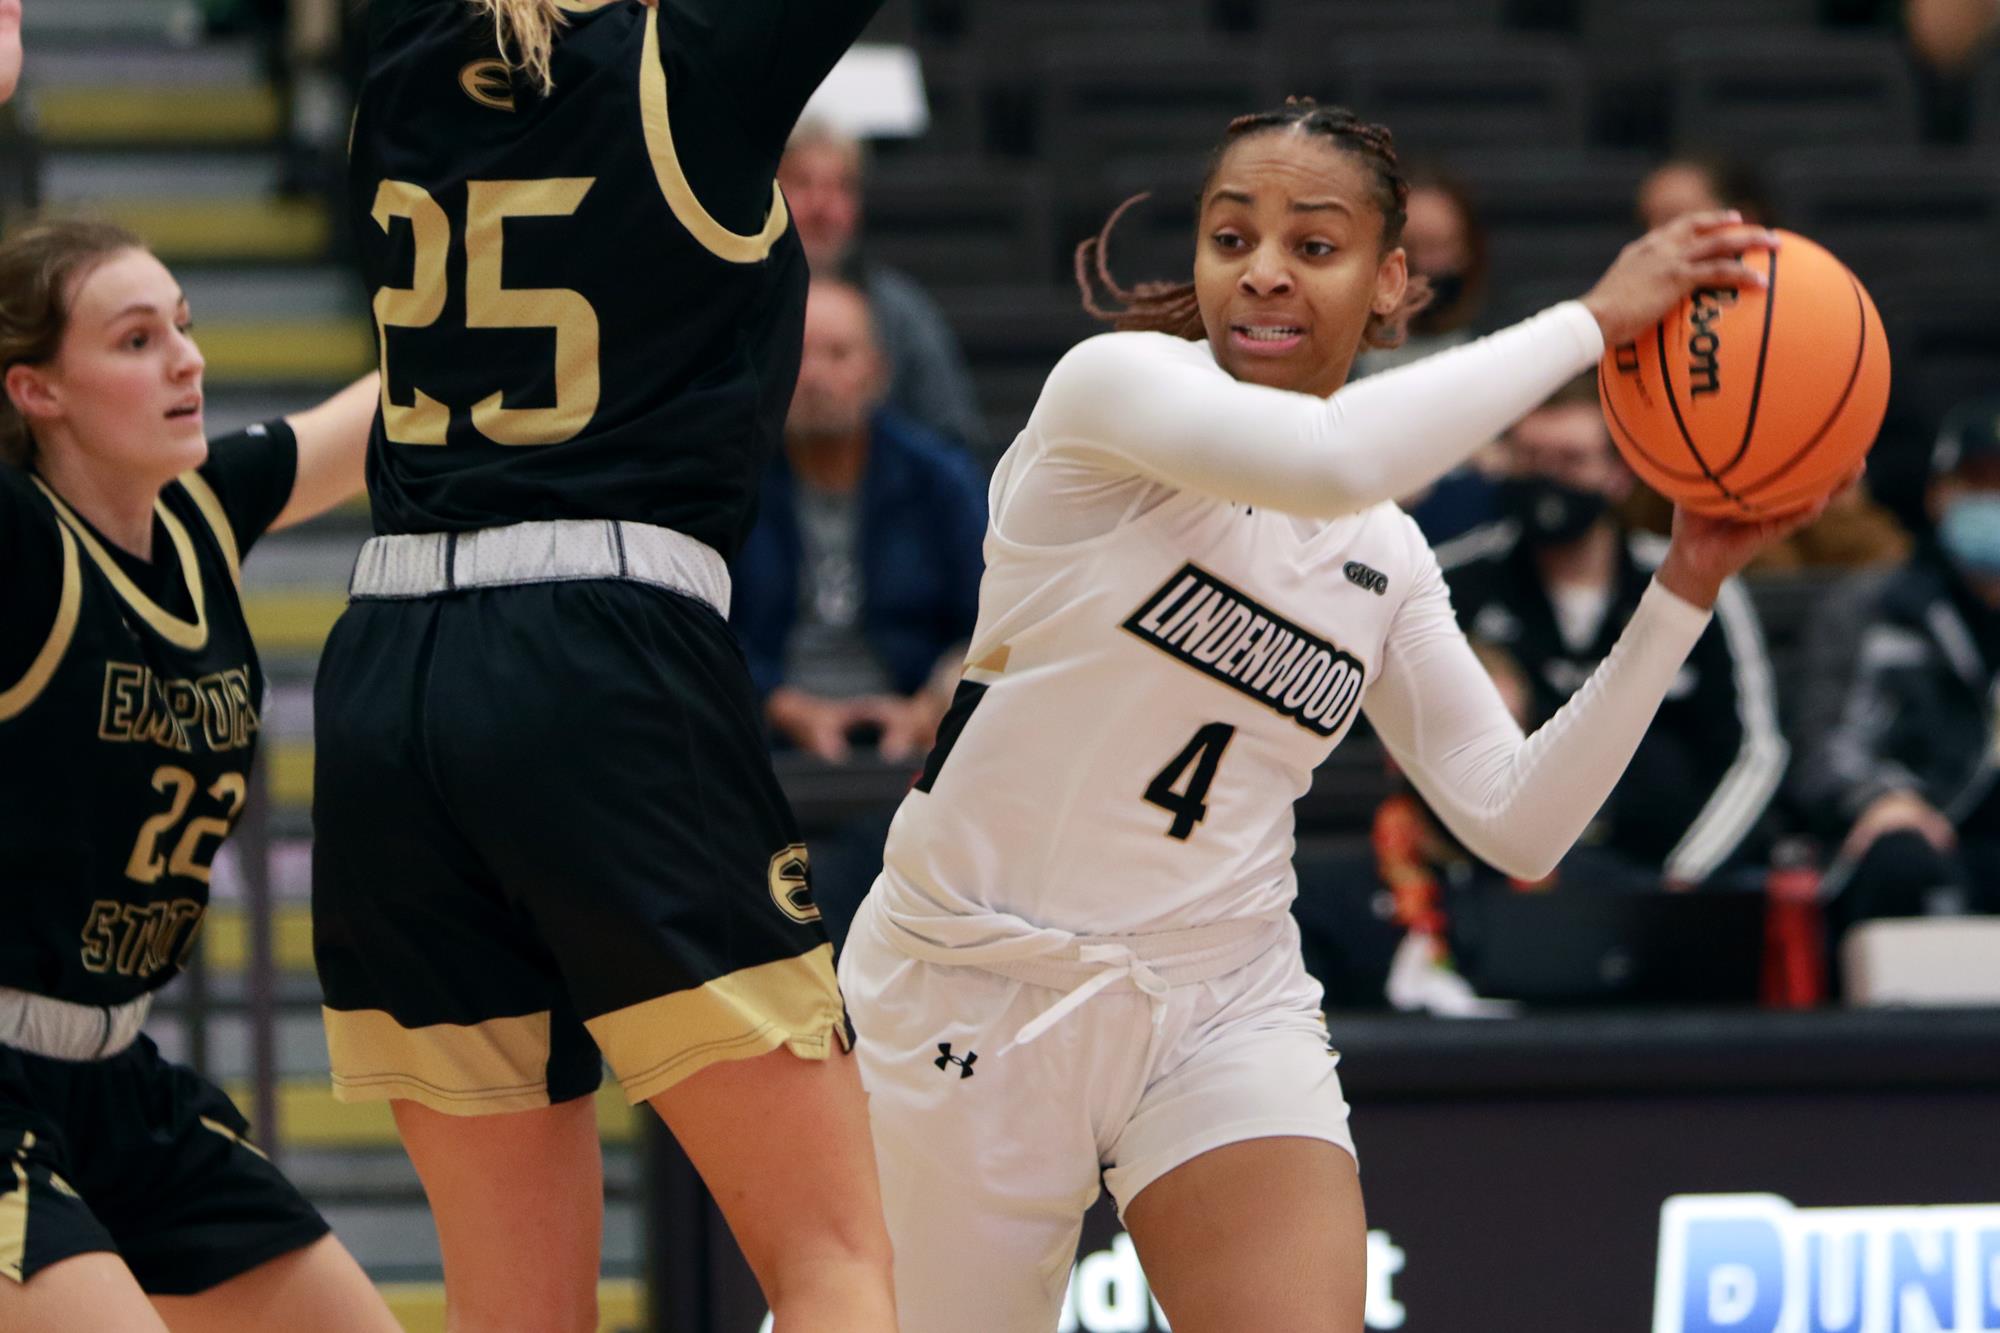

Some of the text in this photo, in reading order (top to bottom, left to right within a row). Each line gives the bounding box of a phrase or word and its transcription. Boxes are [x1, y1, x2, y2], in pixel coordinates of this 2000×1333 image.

[370, 176, 600, 446] 25
[1137, 572, 1363, 731] LINDENWOOD
[124, 764, 248, 884] 22
[1140, 721, 1237, 843] 4
